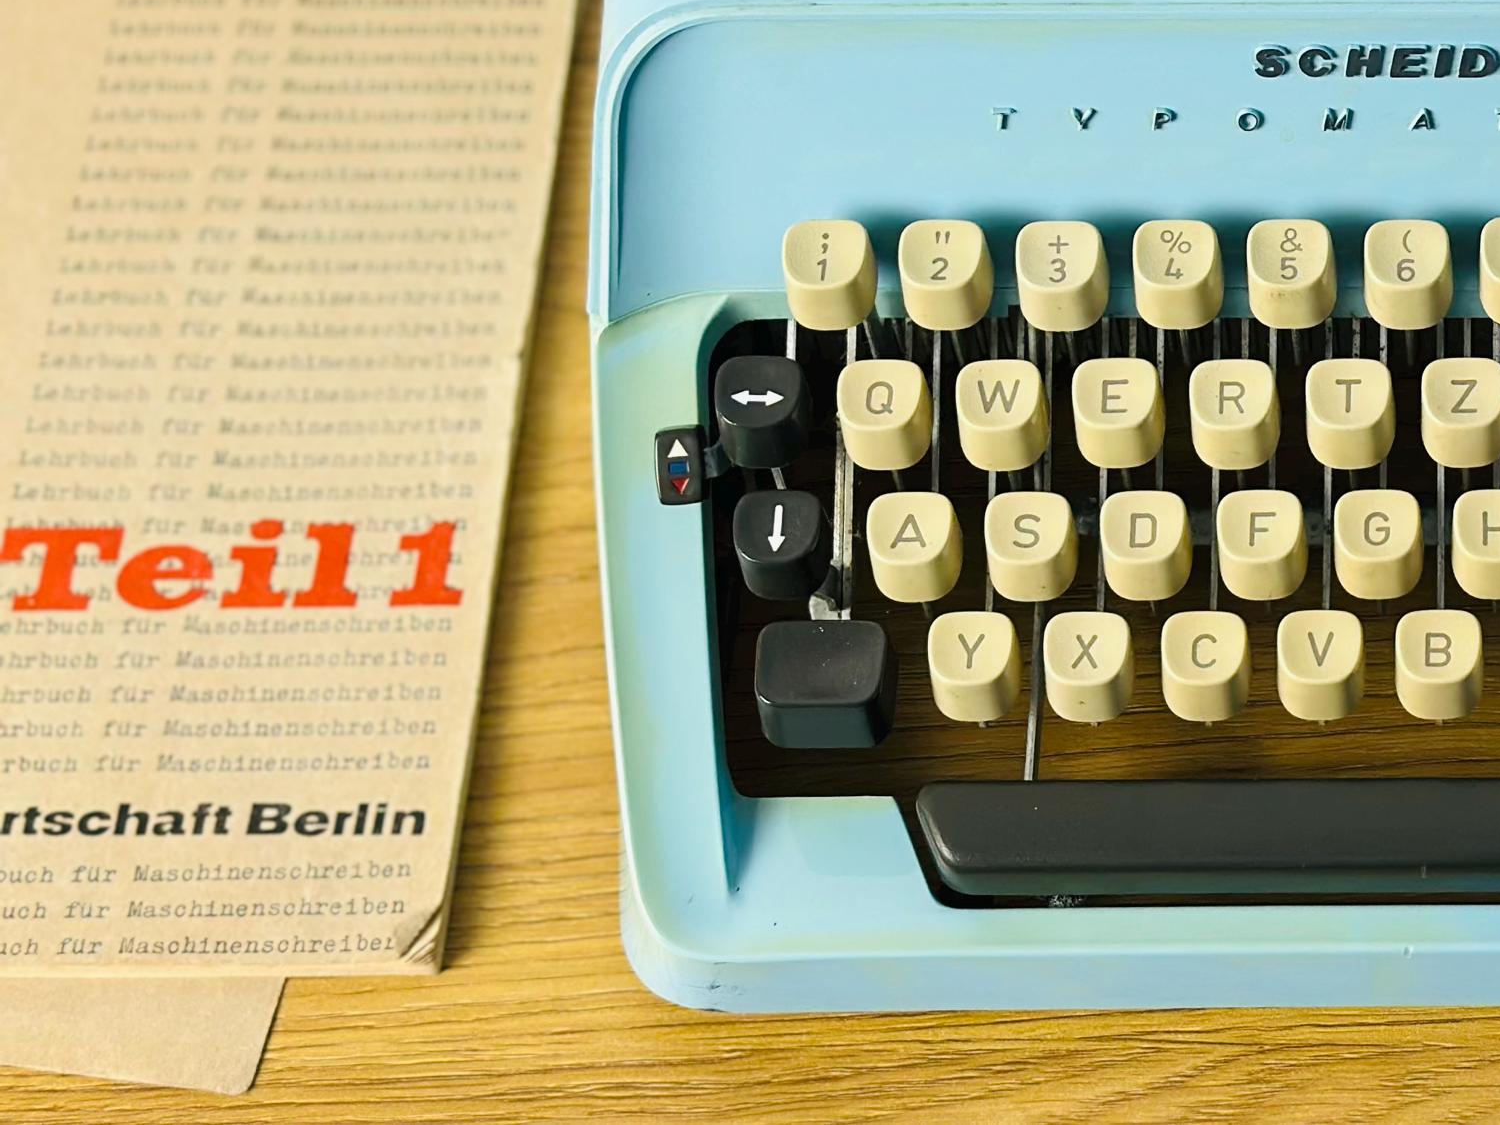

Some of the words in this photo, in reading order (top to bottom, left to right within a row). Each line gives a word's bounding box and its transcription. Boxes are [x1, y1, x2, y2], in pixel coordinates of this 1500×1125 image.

[1047, 234, 1070, 255] +
[1160, 229, 1192, 254] %
[1279, 227, 1303, 254] &
[1402, 229, 1412, 254] (
[816, 258, 827, 282] 1
[929, 257, 949, 281] 2
[1048, 257, 1067, 284] 3
[1163, 257, 1184, 280] 4
[1280, 256, 1298, 281] 5
[1396, 258, 1416, 283] 6
[865, 381, 894, 415] Q
[977, 378, 1021, 414] W
[1100, 378, 1130, 414] E
[1215, 380, 1246, 415] R
[1334, 378, 1362, 414] T
[1450, 379, 1478, 414] Z
[10, 482, 131, 502] Lehrbuch
[148, 482, 192, 502] für
[204, 482, 474, 503] Maschinenschreiben
[889, 513, 927, 550] A
[1012, 513, 1041, 549] S
[1128, 512, 1158, 549] D
[1248, 511, 1277, 548] F
[1363, 511, 1391, 547] G
[0, 519, 355, 612] Teil
[389, 522, 464, 608] 1
[120, 616, 167, 634] für
[181, 614, 453, 636] Maschinenschreiben
[114, 650, 161, 670] für
[173, 649, 448, 670] Maschinenschreiben
[957, 633, 986, 670] Y
[1070, 634, 1098, 670] X
[1191, 633, 1218, 669] C
[1307, 631, 1335, 668] V
[1424, 632, 1452, 668] B
[0, 685, 92, 705] hrbuch
[109, 684, 155, 704] für
[168, 684, 442, 704] Maschinenschreiben
[102, 720, 147, 738] für
[161, 718, 437, 738] Maschinenschreiben
[1, 756, 78, 774] rbuch
[94, 754, 141, 773] für
[155, 752, 431, 773] Maschinenschreiben
[0, 803, 232, 837] rtschaft
[246, 803, 427, 837] Berlin
[71, 865, 118, 884] für
[132, 863, 411, 883] Maschinenschreiben
[1, 901, 47, 920] uch
[64, 901, 111, 919] für
[126, 899, 405, 919] Maschinenschreiben
[56, 937, 103, 956] für
